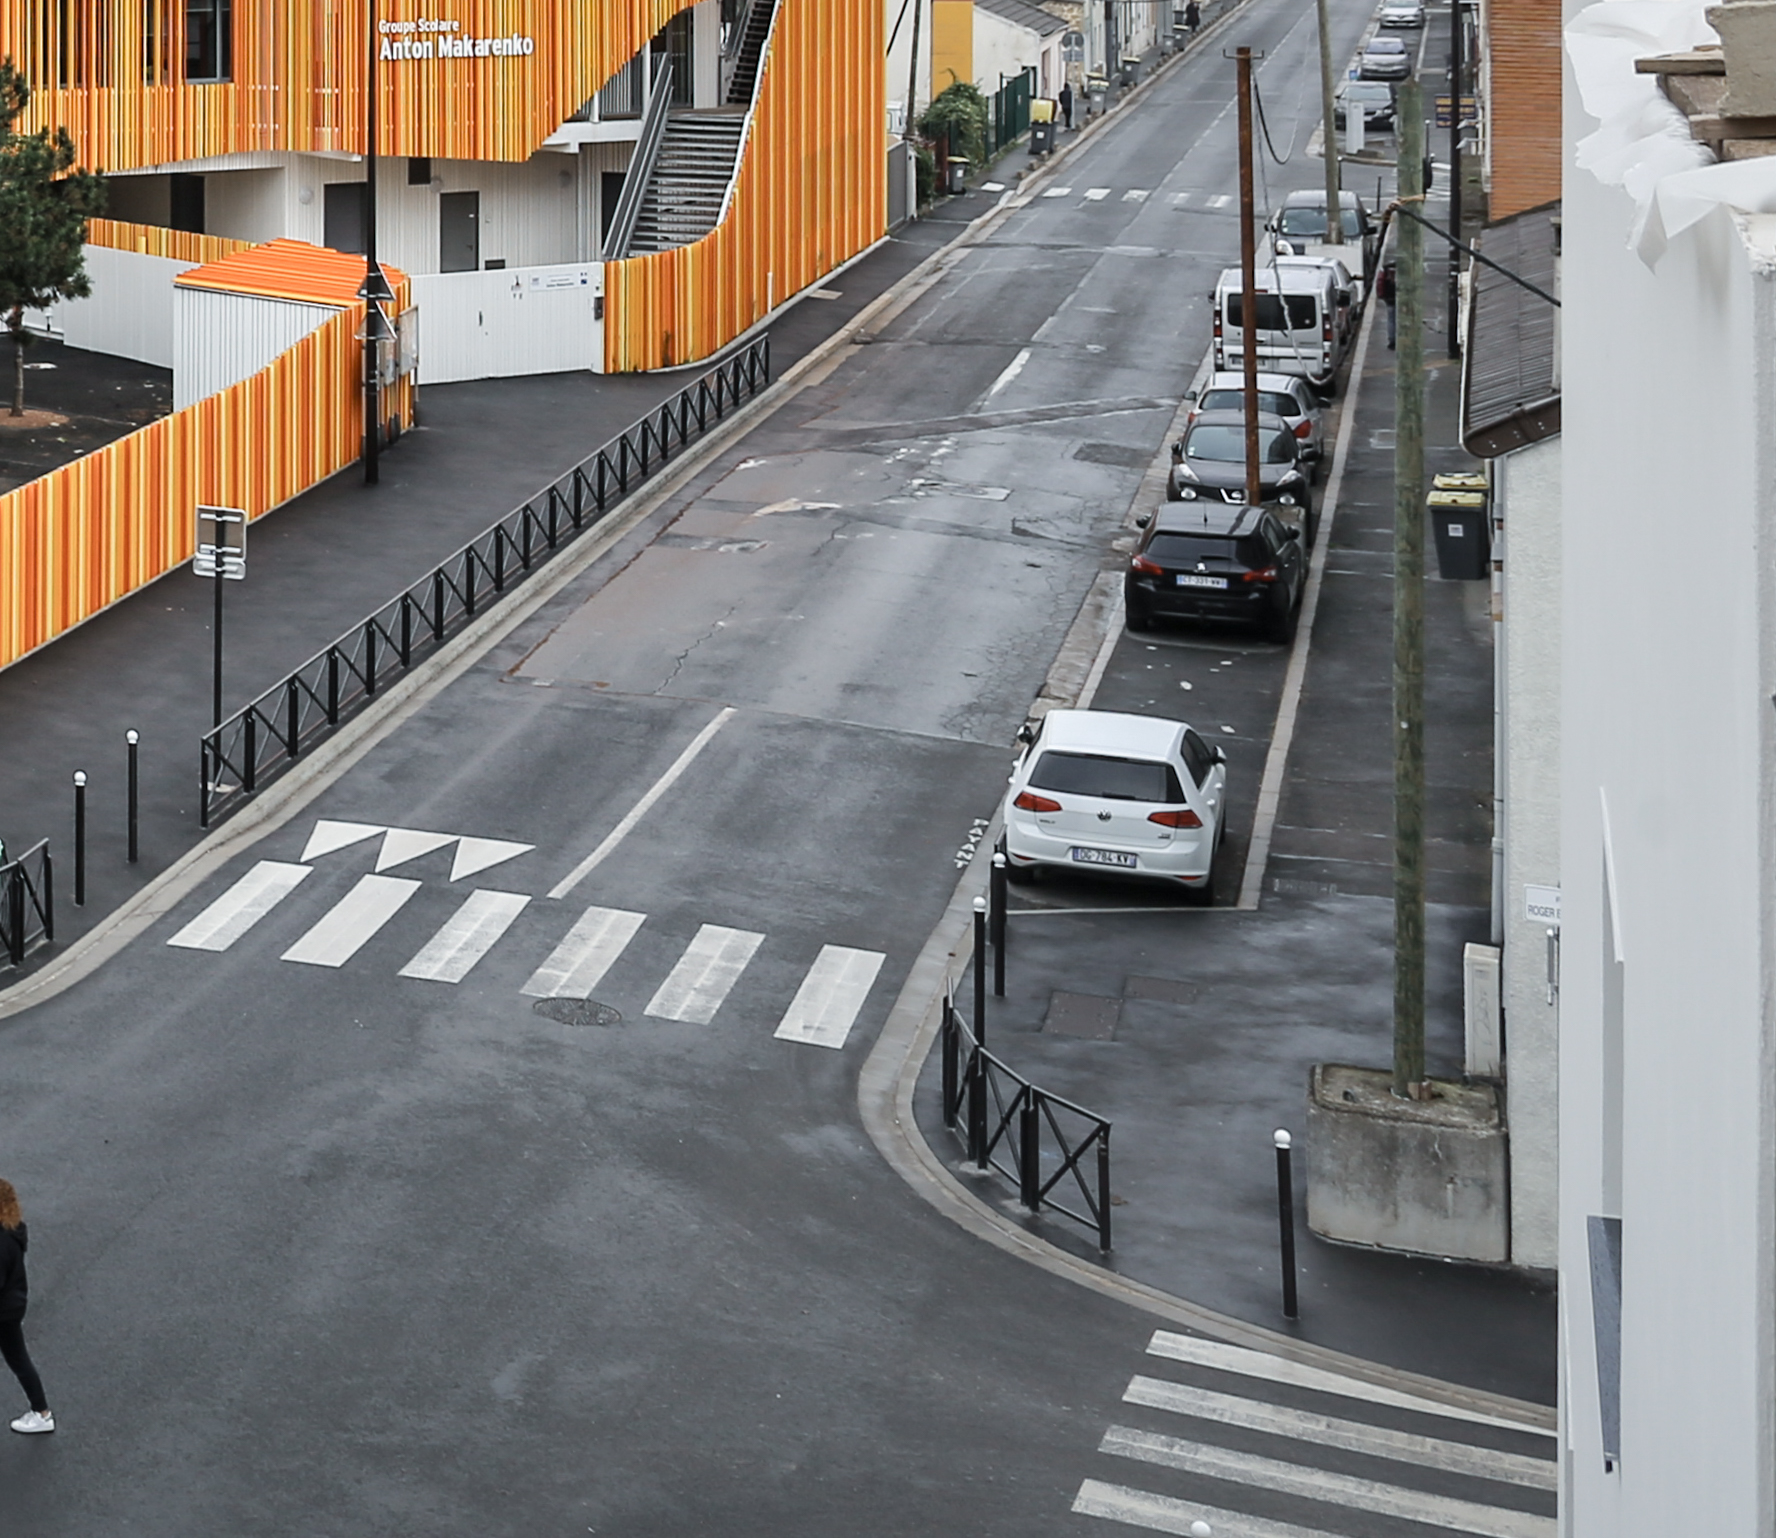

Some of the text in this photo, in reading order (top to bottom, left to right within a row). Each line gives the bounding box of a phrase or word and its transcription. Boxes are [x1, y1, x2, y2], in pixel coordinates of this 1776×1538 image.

[378, 18, 460, 34] Groupe Scolaire
[379, 32, 534, 61] Anton Makarenko
[953, 818, 990, 869] PAYANT
[1528, 904, 1555, 918] ROGER
